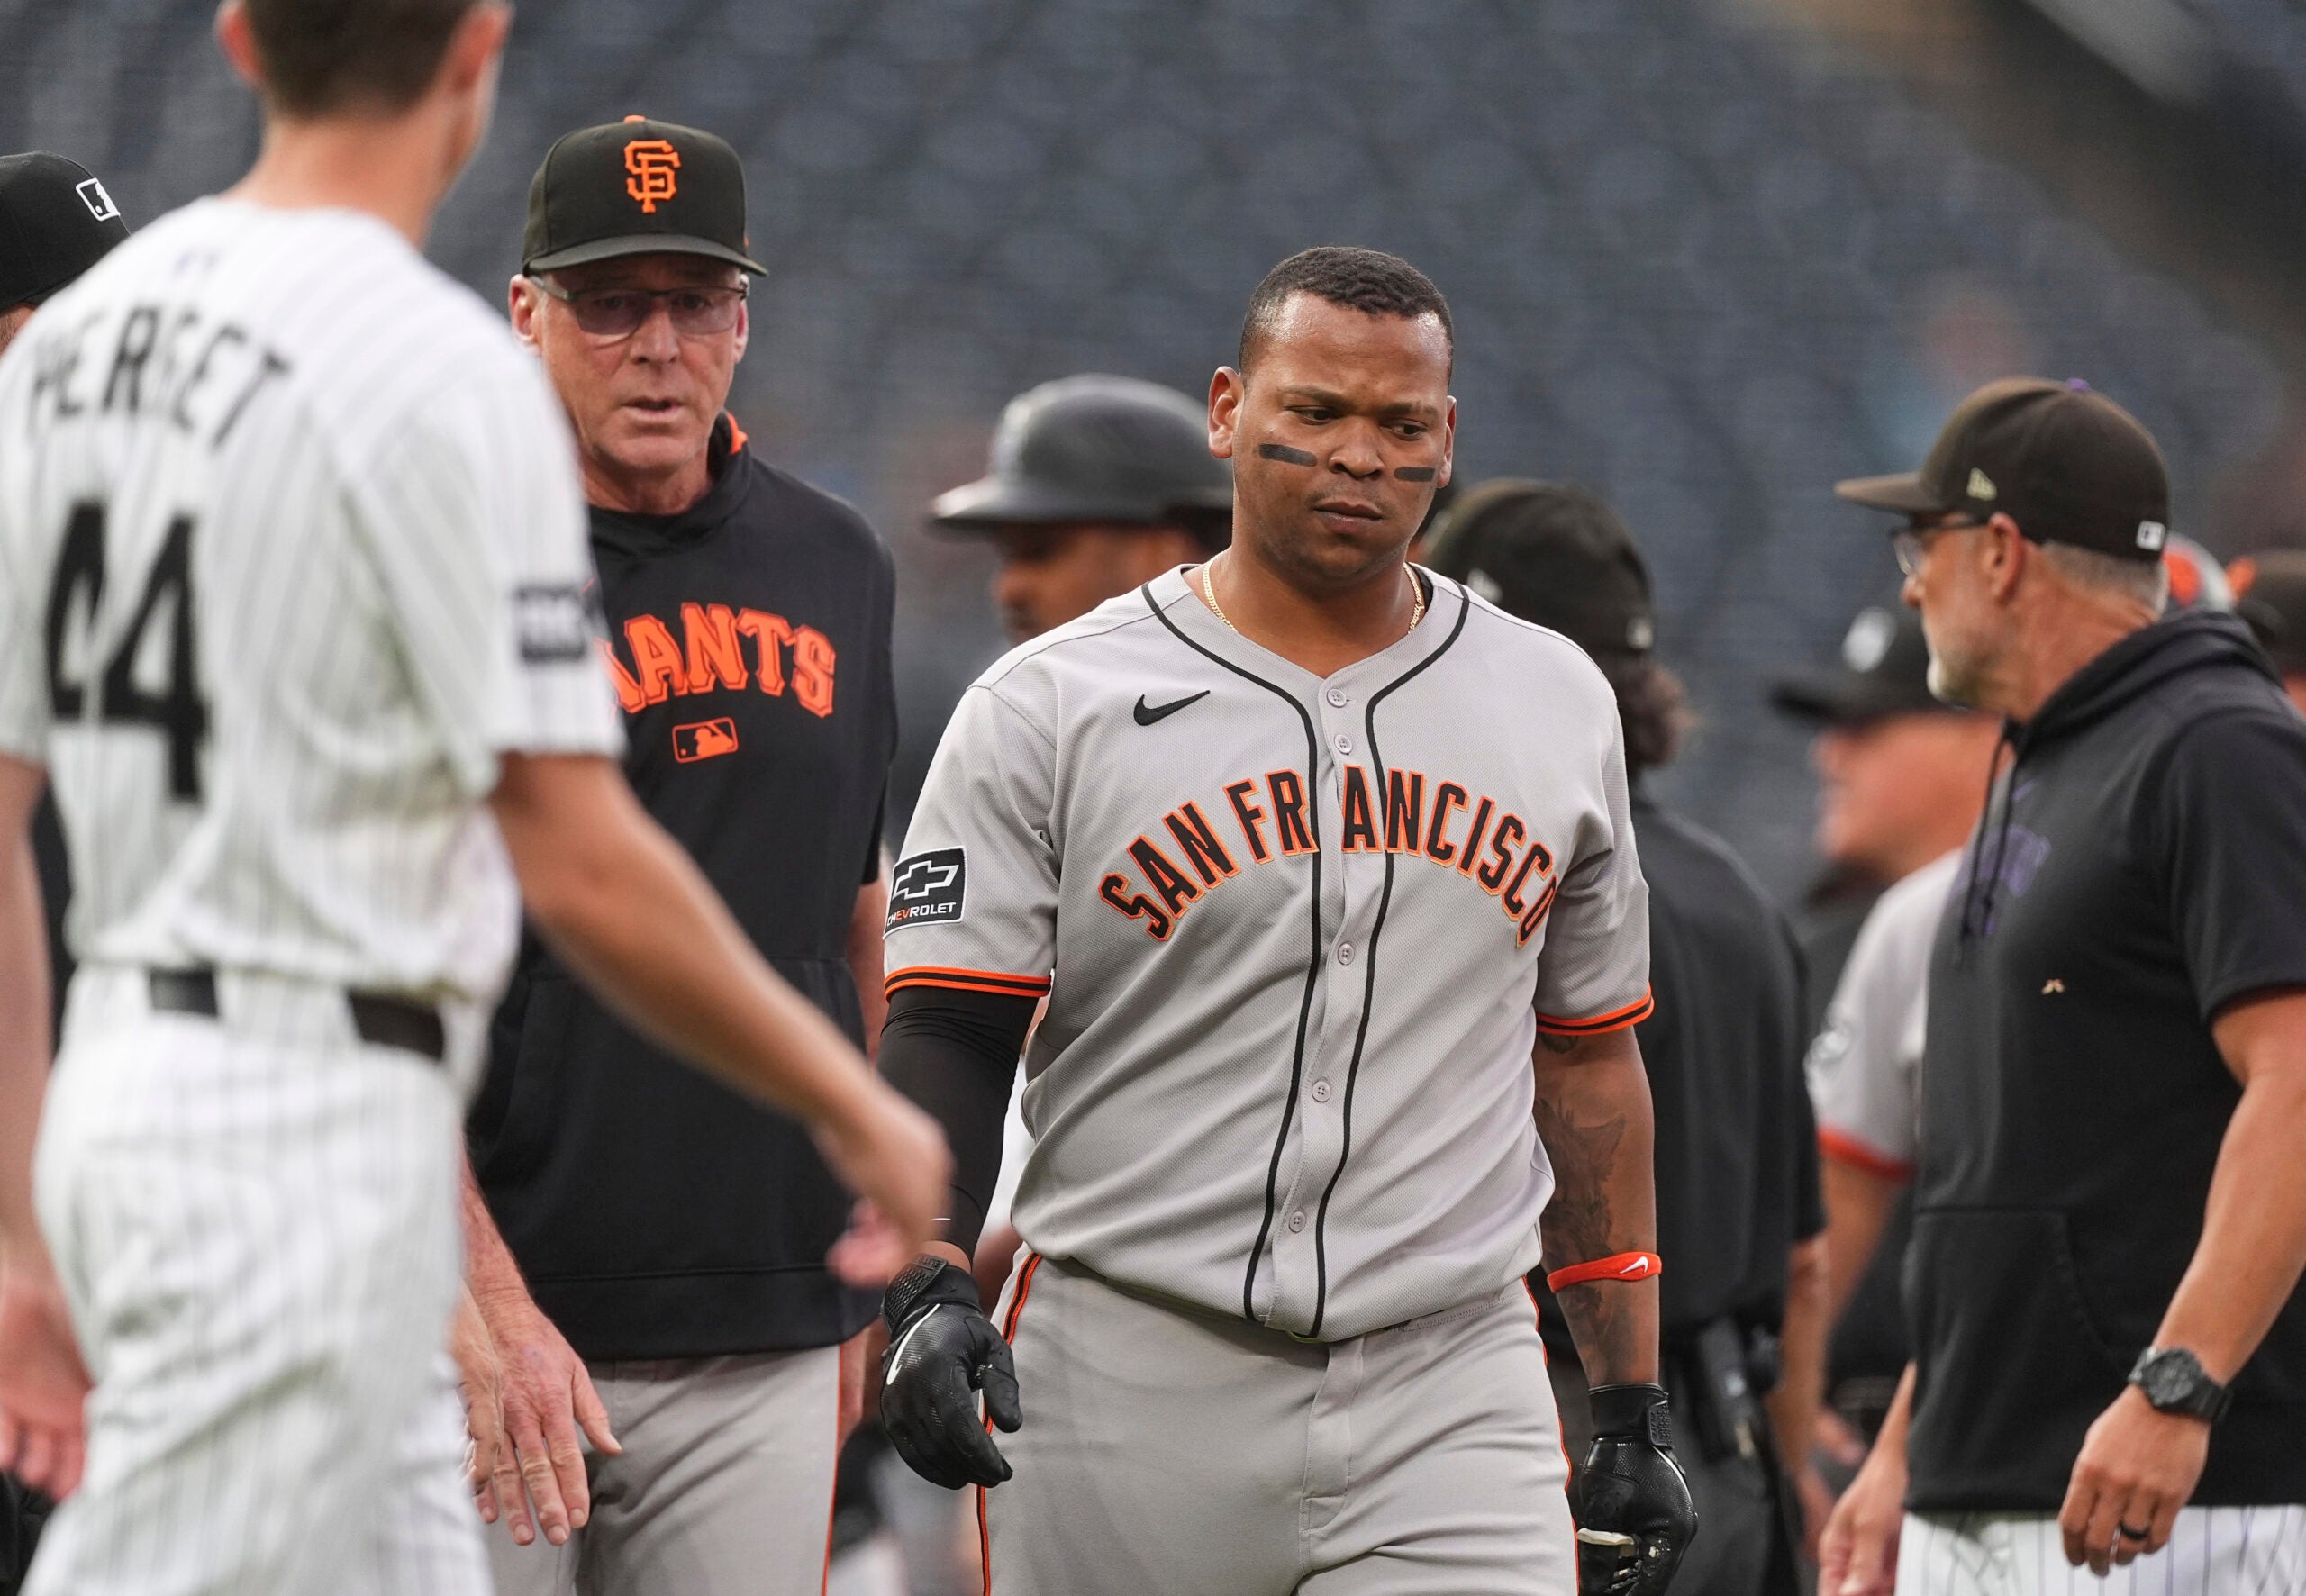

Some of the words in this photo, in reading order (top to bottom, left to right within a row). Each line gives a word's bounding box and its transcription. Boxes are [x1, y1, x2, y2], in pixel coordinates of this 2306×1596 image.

[623, 139, 681, 214] SF
[45, 498, 213, 804] 44
[886, 902, 957, 927] CHEVROLET
[1096, 800, 1241, 942] SAN
[1222, 764, 1558, 949] FRANCISCO
